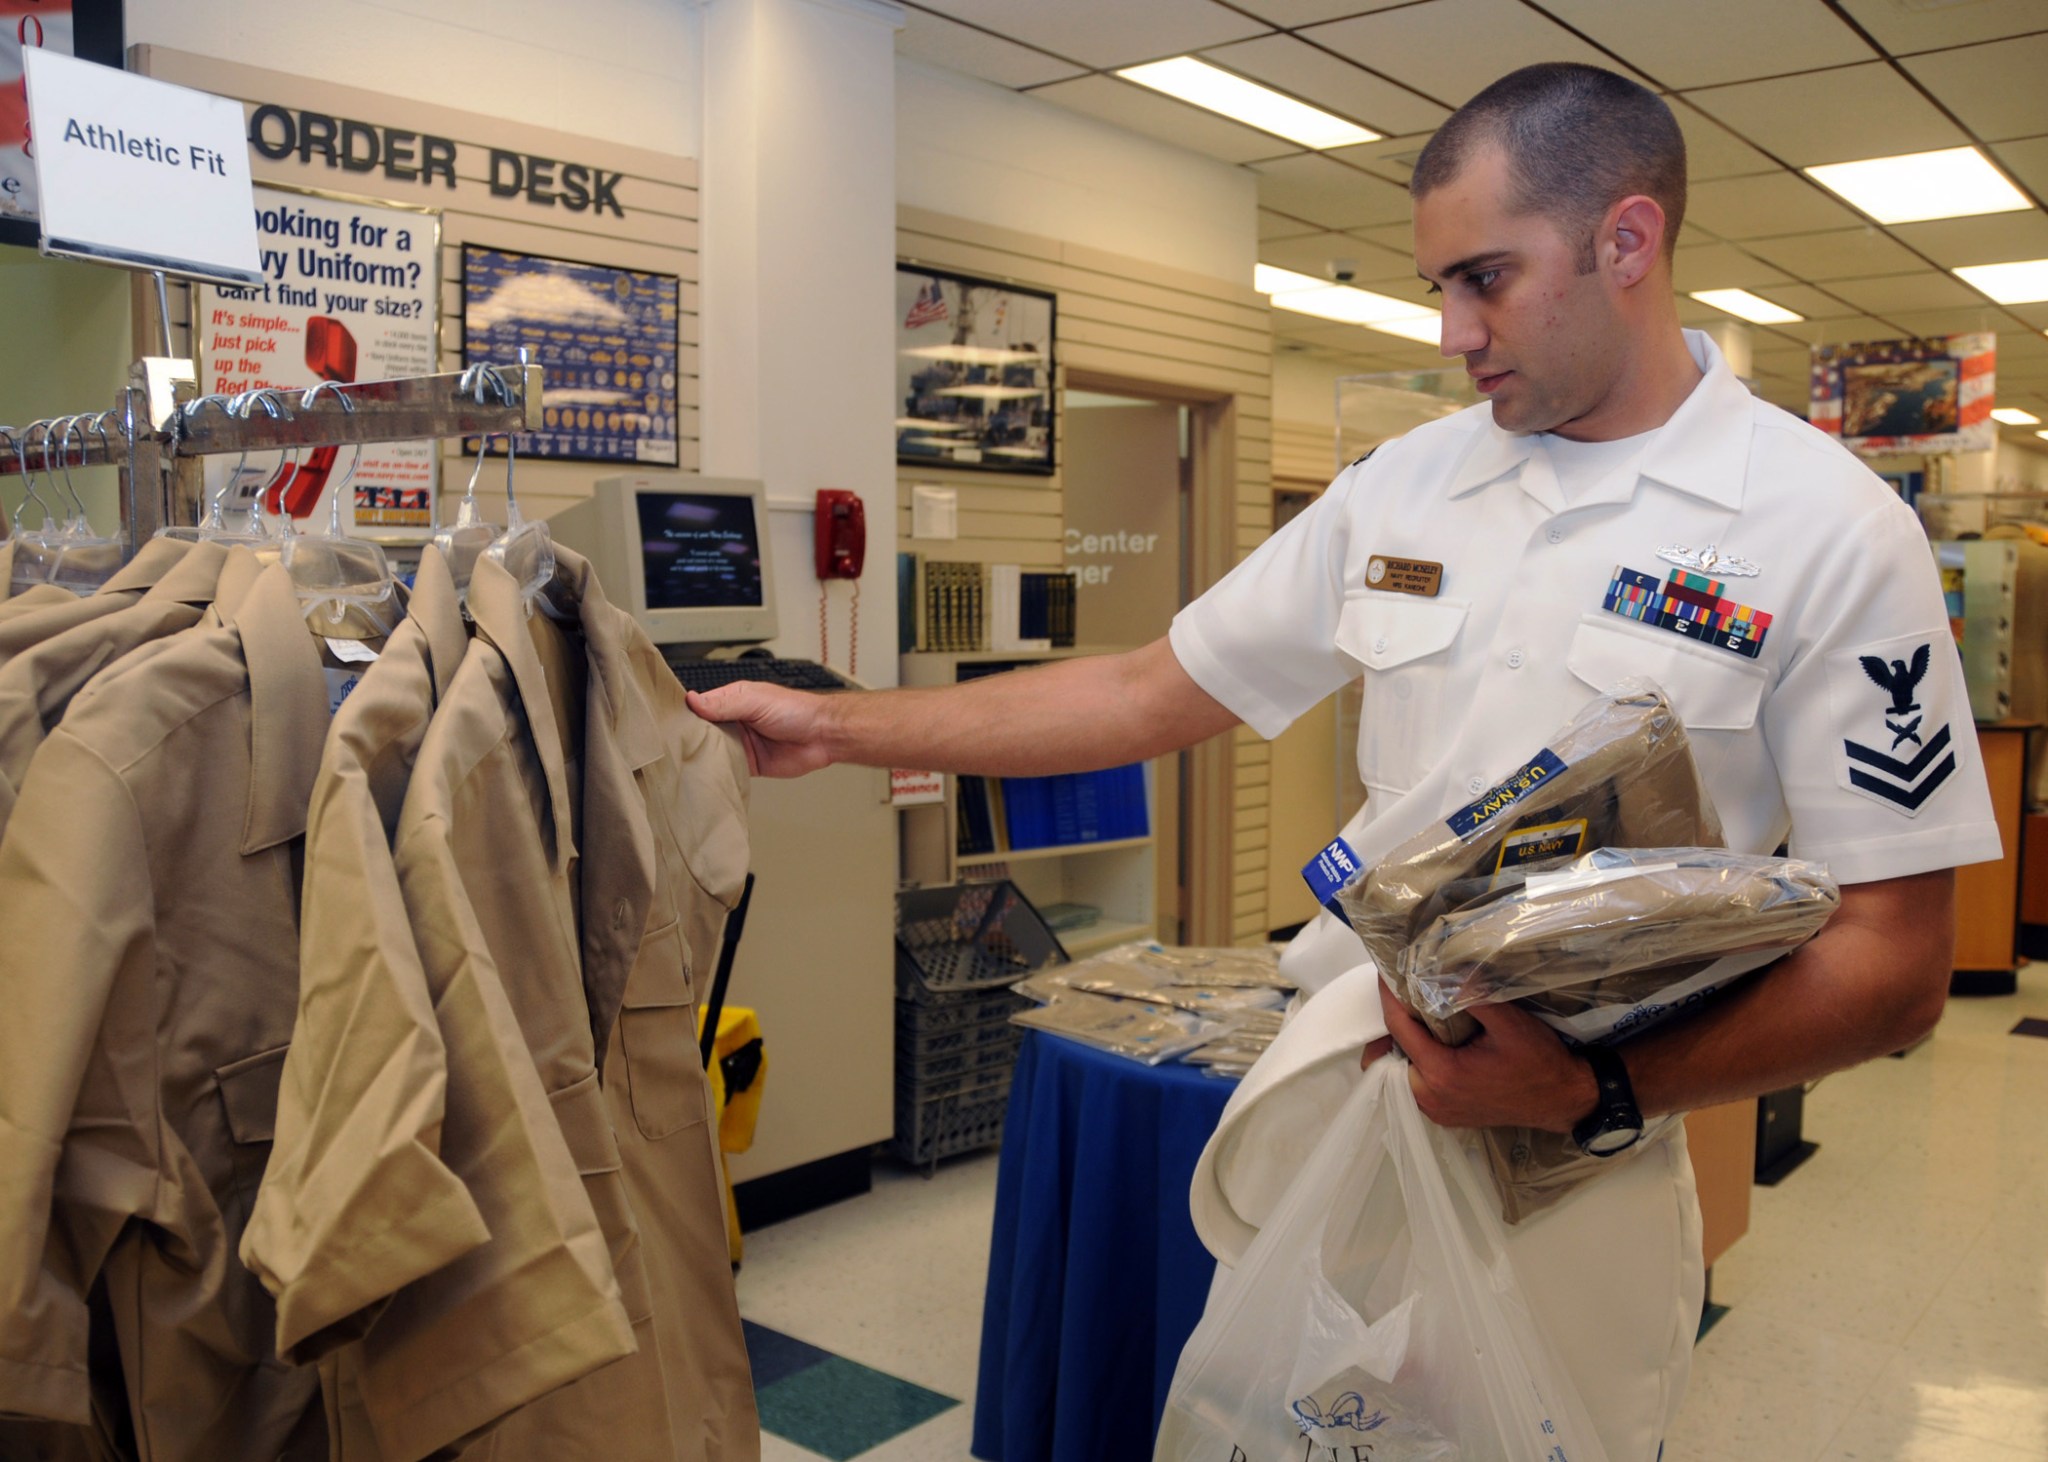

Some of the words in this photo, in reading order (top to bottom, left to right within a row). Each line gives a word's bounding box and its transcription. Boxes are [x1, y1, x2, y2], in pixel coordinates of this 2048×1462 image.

[63, 118, 181, 166] Athletic
[190, 146, 227, 177] Fit
[250, 104, 457, 189] ORDER
[489, 148, 625, 219] DESK
[255, 206, 339, 248] ooking
[350, 217, 387, 248] for
[396, 231, 411, 251] a
[260, 251, 288, 279] vy
[299, 249, 421, 289] Uniform?
[216, 283, 270, 303] Cant
[278, 283, 317, 307] find
[325, 293, 368, 314] your
[375, 297, 422, 319] size?
[212, 310, 234, 326] It's
[240, 313, 300, 333] simple...
[212, 333, 241, 351] just
[246, 335, 276, 354] pick
[214, 359, 233, 375] up
[238, 358, 261, 375] the
[215, 377, 248, 396] Red
[1064, 528, 1159, 554] Center
[1513, 766, 1547, 789] U.S.
[1473, 789, 1516, 824] NAVY
